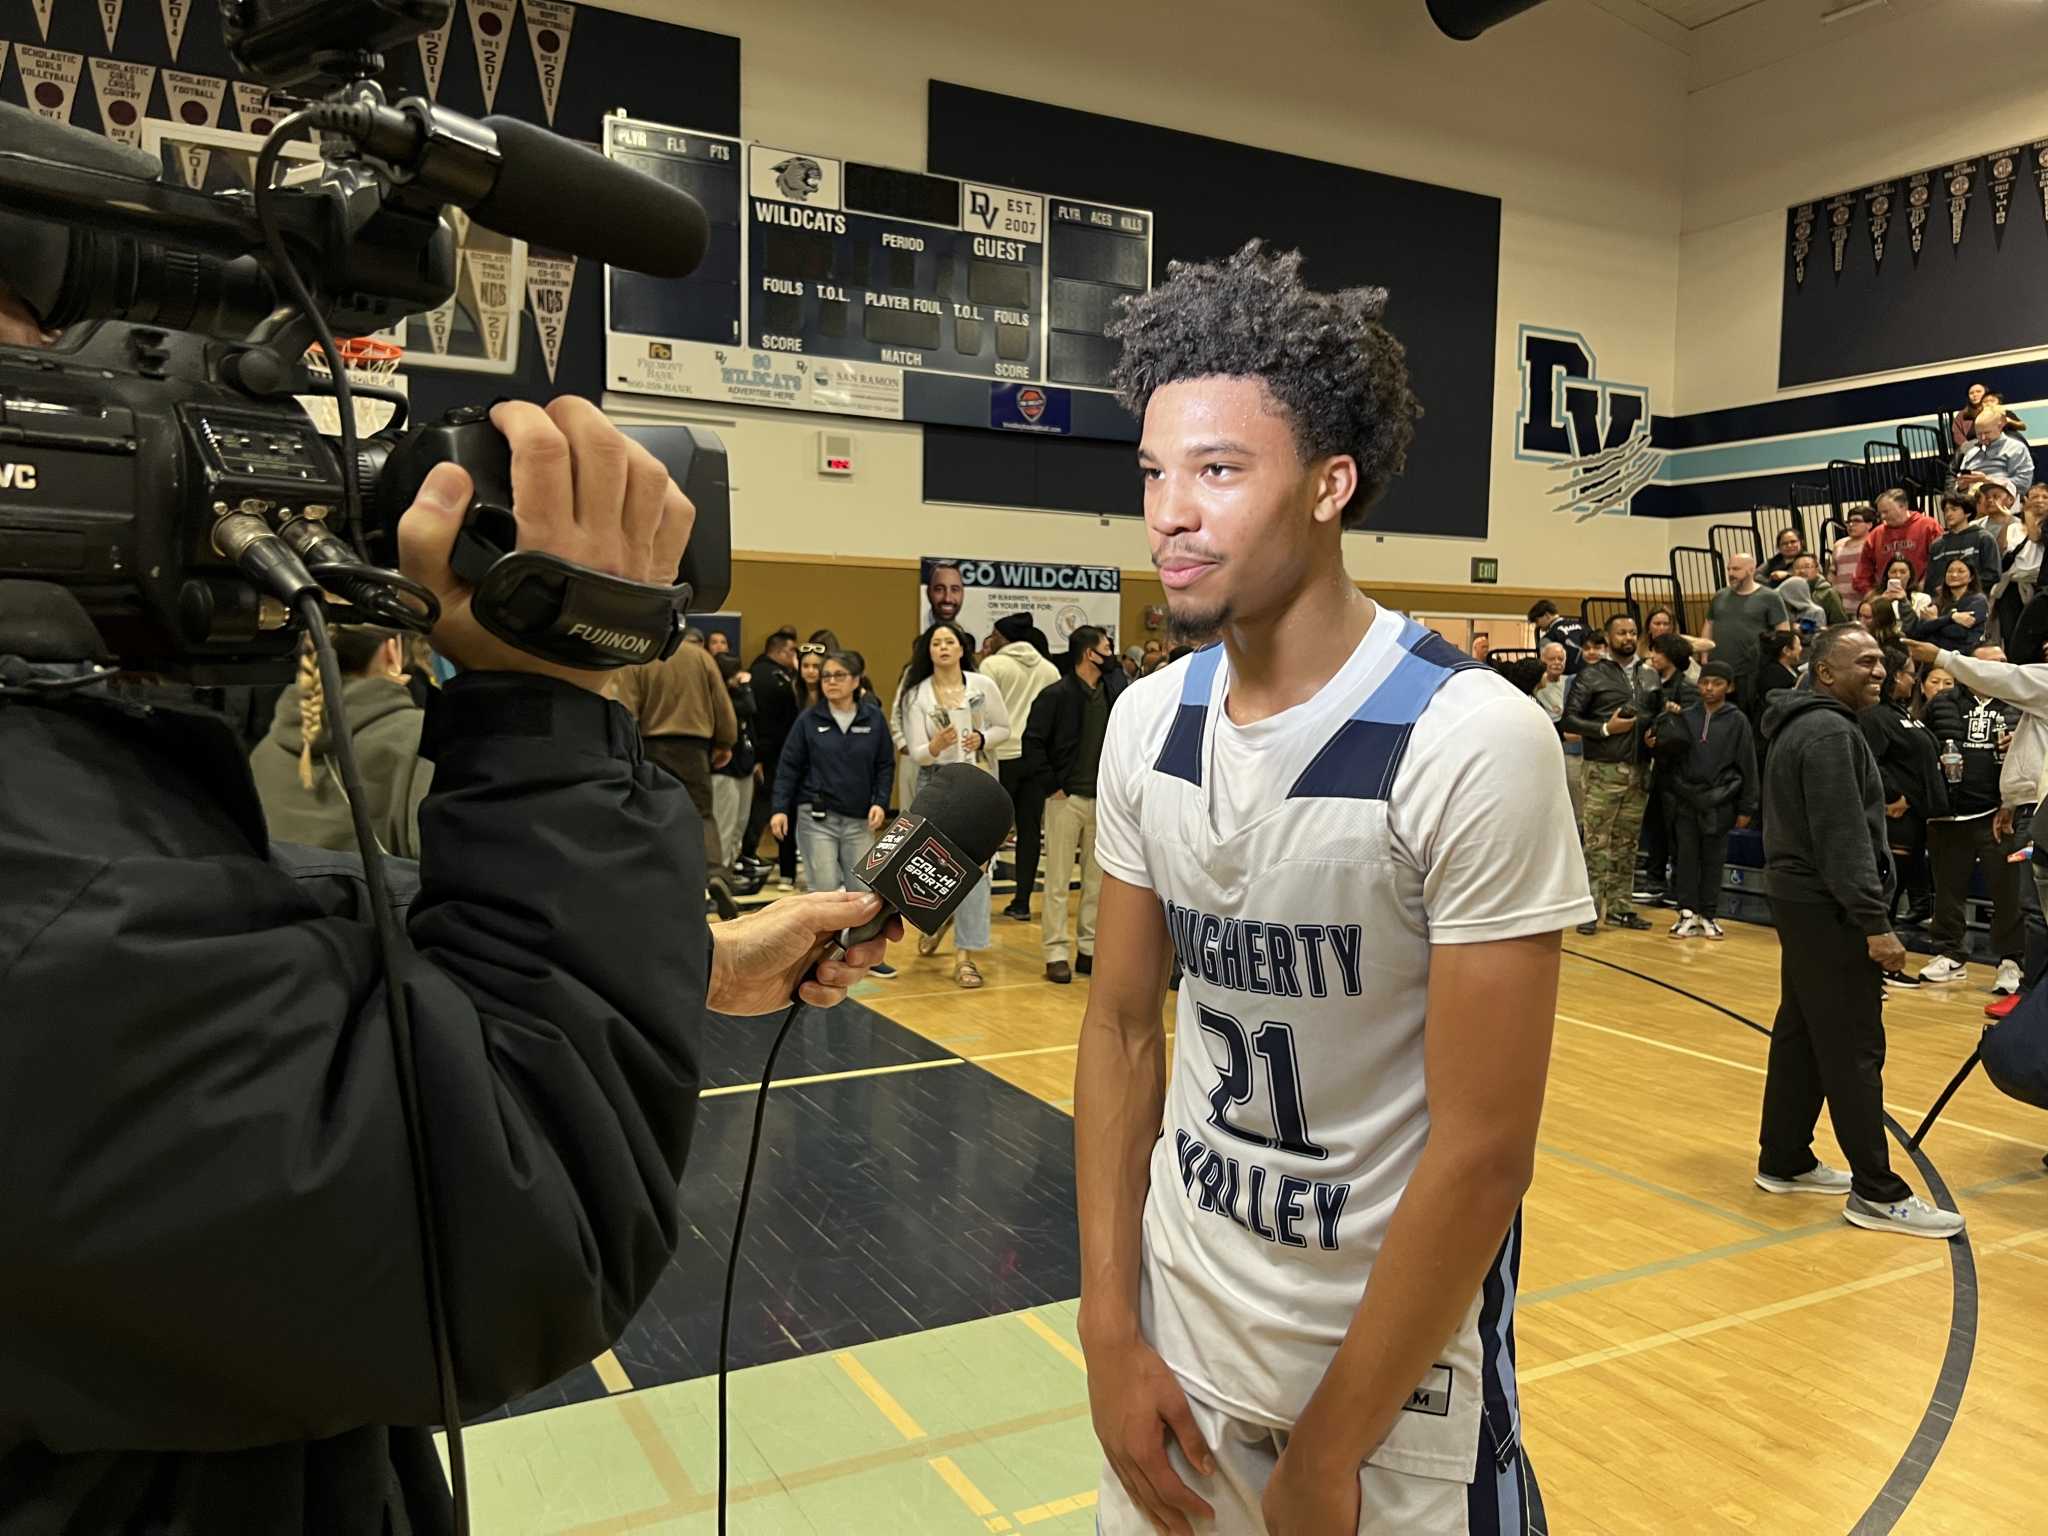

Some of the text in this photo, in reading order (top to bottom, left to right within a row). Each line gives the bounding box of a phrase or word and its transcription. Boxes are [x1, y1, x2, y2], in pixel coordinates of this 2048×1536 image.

[104, 0, 116, 33] 014
[21, 47, 77, 64] SCHOLASTIC
[22, 67, 77, 84] VOLLEYBALL
[96, 61, 149, 76] SCHOLASTIC
[168, 73, 221, 89] SCHOLASTIC
[173, 85, 216, 100] FOOTBALL
[103, 87, 141, 100] COUNTRY
[667, 136, 687, 153] FLS
[709, 144, 729, 161] PTS
[755, 202, 846, 235] WILDCATS
[1007, 198, 1036, 216] EST.
[1004, 217, 1036, 236] 2007
[1090, 211, 1113, 227] ACES
[1120, 216, 1143, 232] KILLS
[882, 232, 925, 252] PERIOD
[973, 237, 1027, 262] GUEST
[529, 278, 569, 288] BADMINTON
[762, 277, 850, 302] FOULS T.O.L.
[864, 291, 942, 315] PLAYER FOUL
[953, 303, 1030, 327] T.O.L. FOULS
[762, 334, 802, 352] SCORE
[880, 348, 922, 367] MATCH
[721, 367, 802, 391] WILDCATS
[994, 362, 1030, 379] SCORE
[1514, 323, 1649, 517] DV
[0, 463, 37, 490] VC
[960, 563, 1118, 591] GO WILDCATS!
[1478, 561, 1496, 580] EXIT
[1000, 602, 1019, 610] YOUR
[567, 623, 652, 654] FUJINON
[904, 864, 950, 895] SPORTS
[910, 856, 957, 888] CAL-HI
[1167, 899, 1362, 998] OUGHERTY
[1196, 1000, 1329, 1161] 21
[1176, 1128, 1351, 1251] VALLEY
